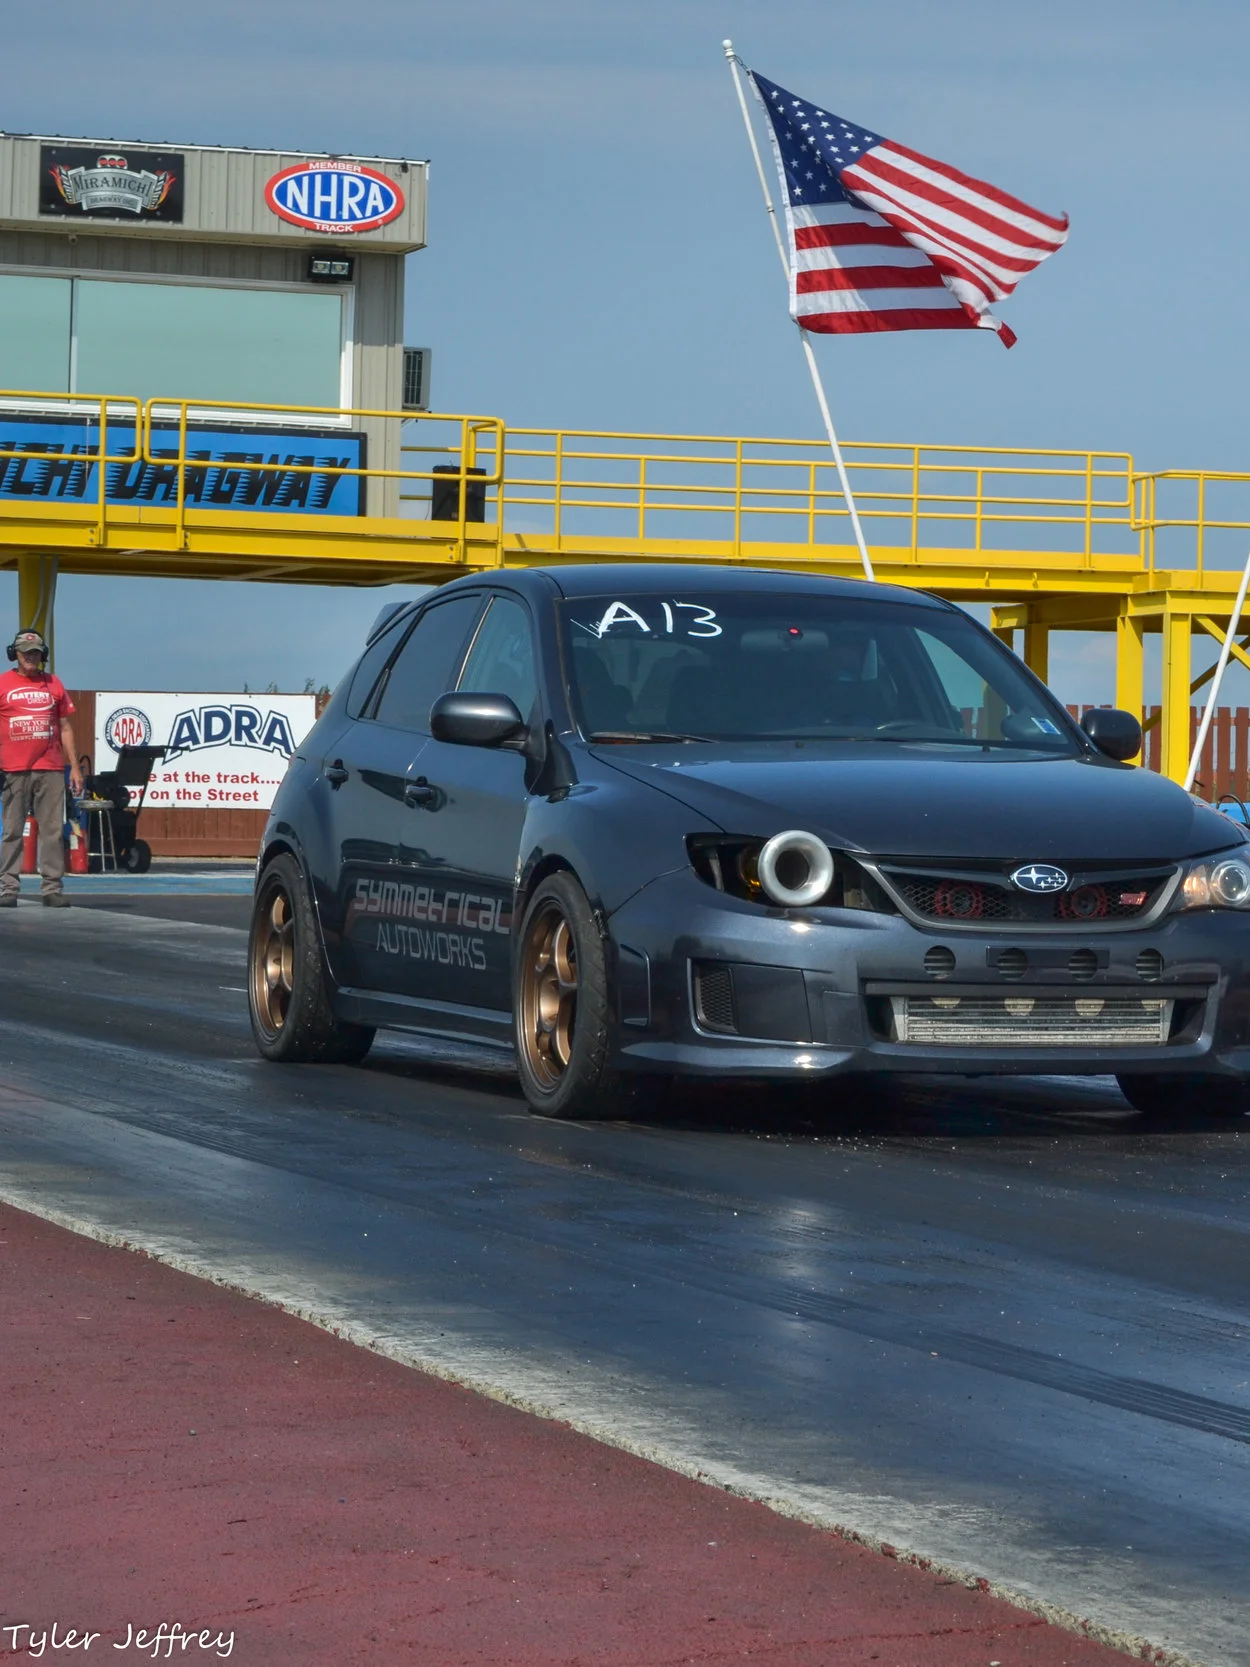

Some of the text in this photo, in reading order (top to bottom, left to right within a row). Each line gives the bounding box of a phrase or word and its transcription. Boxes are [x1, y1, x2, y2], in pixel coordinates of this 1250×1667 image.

[309, 162, 361, 172] MEMBER
[73, 175, 152, 197] MIRAMICHI
[286, 174, 384, 219] NHRA
[314, 223, 353, 232] TRACK
[104, 446, 351, 509] DRAGWAY
[114, 718, 142, 744] ADRA
[164, 705, 295, 763] ADRA
[163, 771, 179, 782] at
[185, 771, 211, 783] the
[150, 790, 170, 800] on
[176, 788, 201, 800] the
[207, 788, 259, 801] Street
[376, 922, 487, 970] AUTOWORKS
